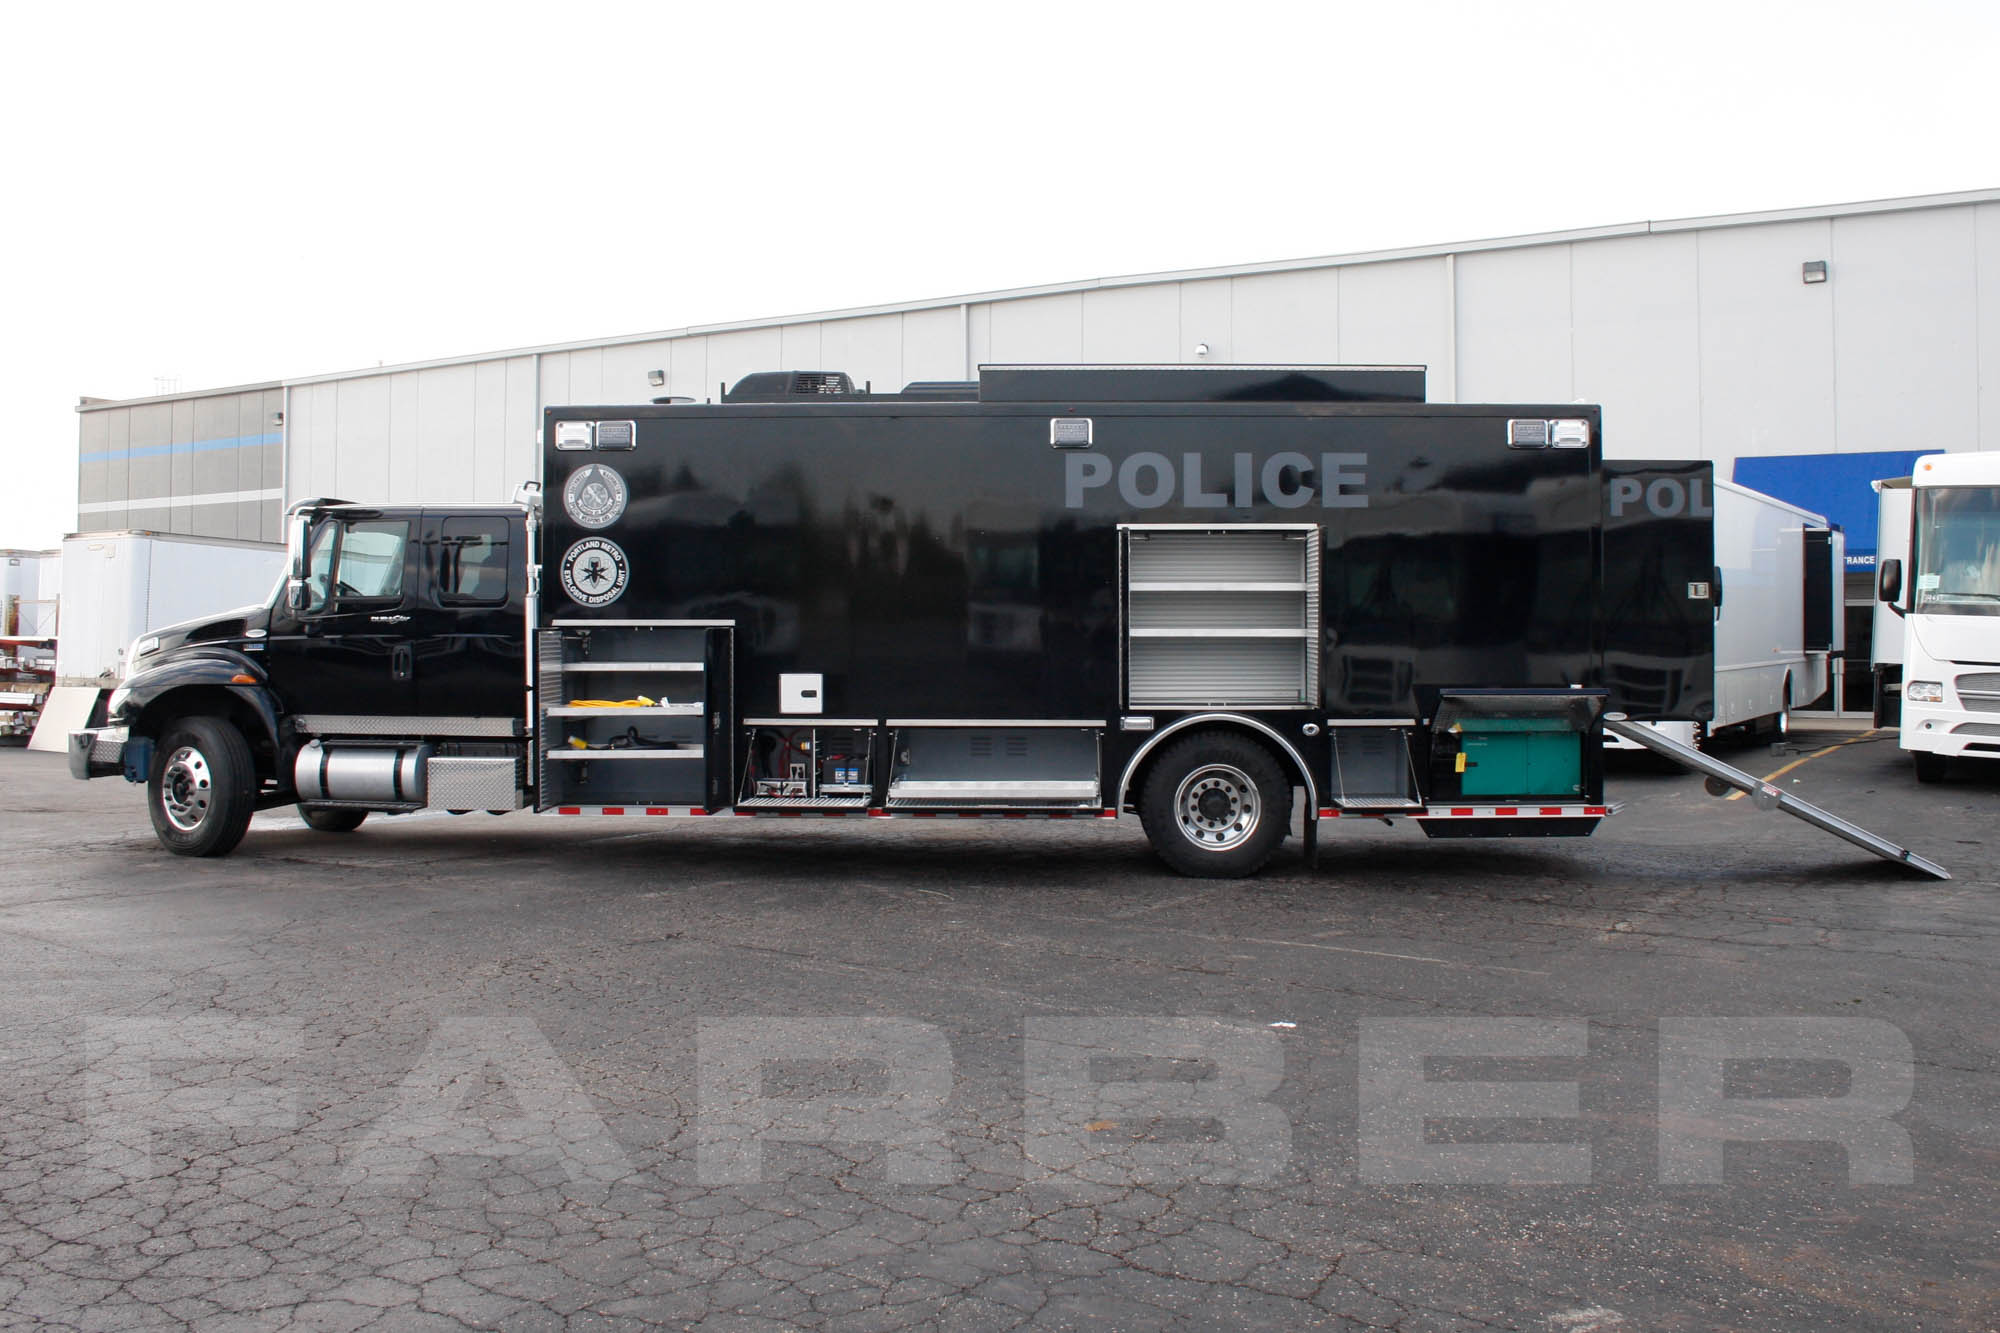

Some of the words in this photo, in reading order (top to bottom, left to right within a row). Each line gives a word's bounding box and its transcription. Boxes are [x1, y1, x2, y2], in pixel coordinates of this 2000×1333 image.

[1065, 452, 1369, 508] POLICE
[1610, 478, 1713, 517] POL
[568, 541, 600, 561] PORTLAND
[601, 542, 621, 561] METRO
[564, 570, 588, 602] EXPLOSIVE
[588, 586, 620, 604] DISPOSAL
[616, 570, 625, 586] UNIT
